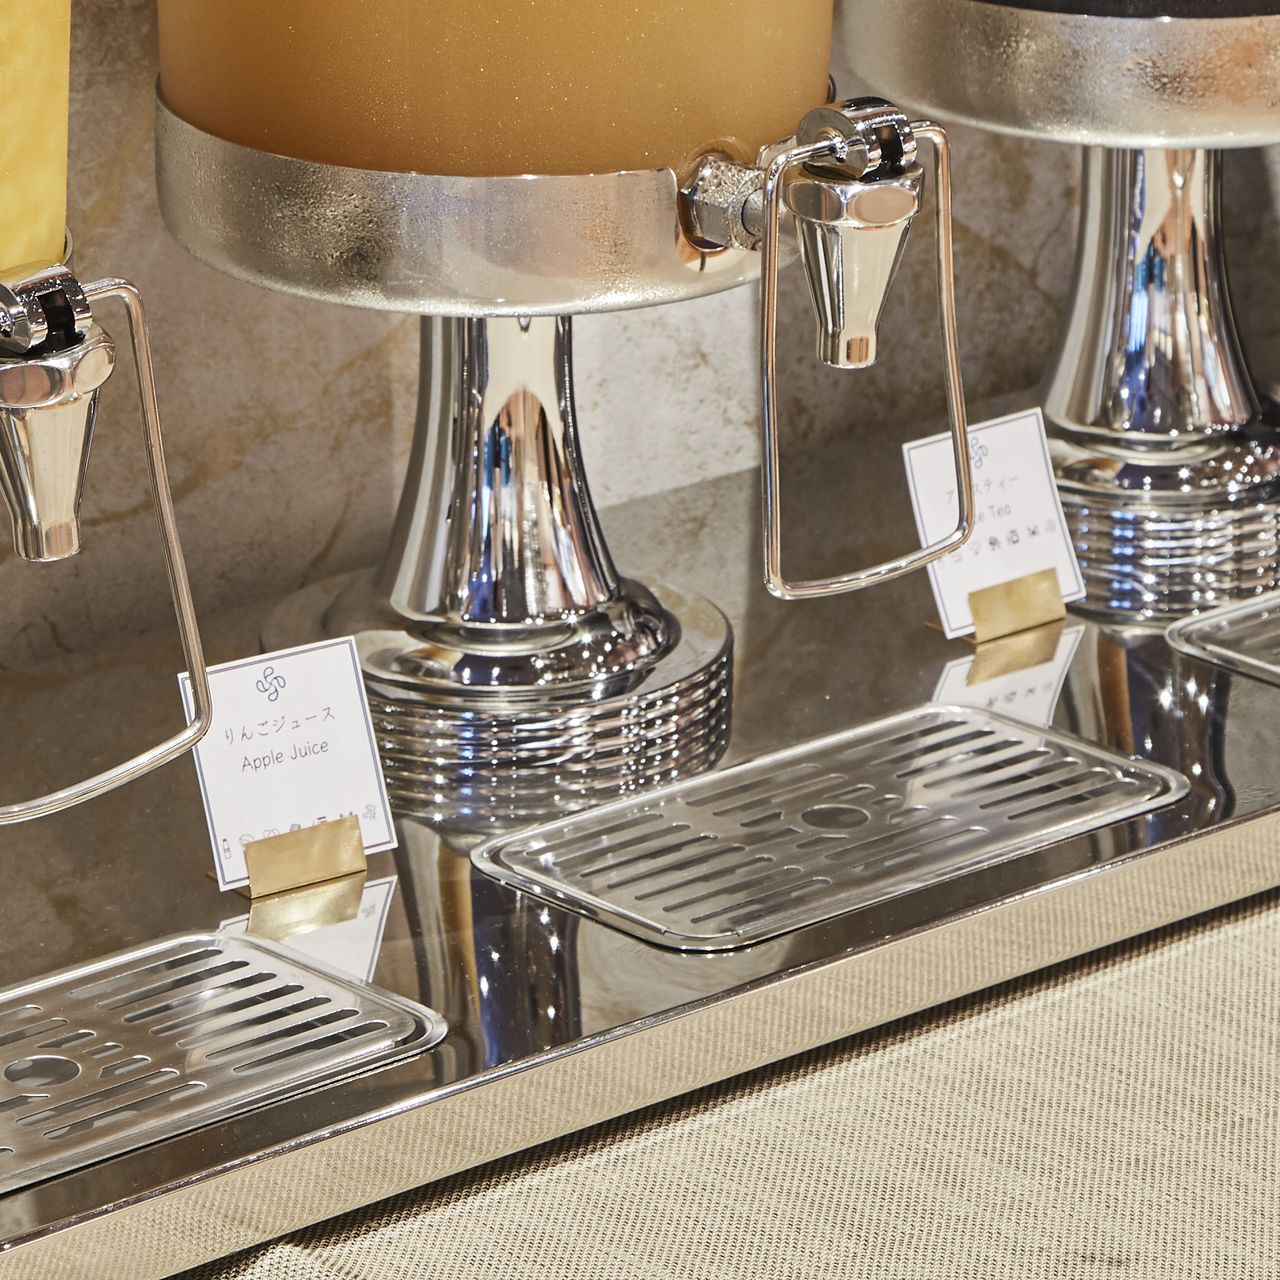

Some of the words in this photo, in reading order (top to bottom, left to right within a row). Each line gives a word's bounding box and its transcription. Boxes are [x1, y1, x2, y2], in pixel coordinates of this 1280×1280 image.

[946, 476, 1018, 505] アスティー
[988, 504, 1012, 519] Tea
[225, 706, 336, 745] りんごジュース
[241, 751, 284, 772] Apple
[290, 739, 329, 760] Juice
